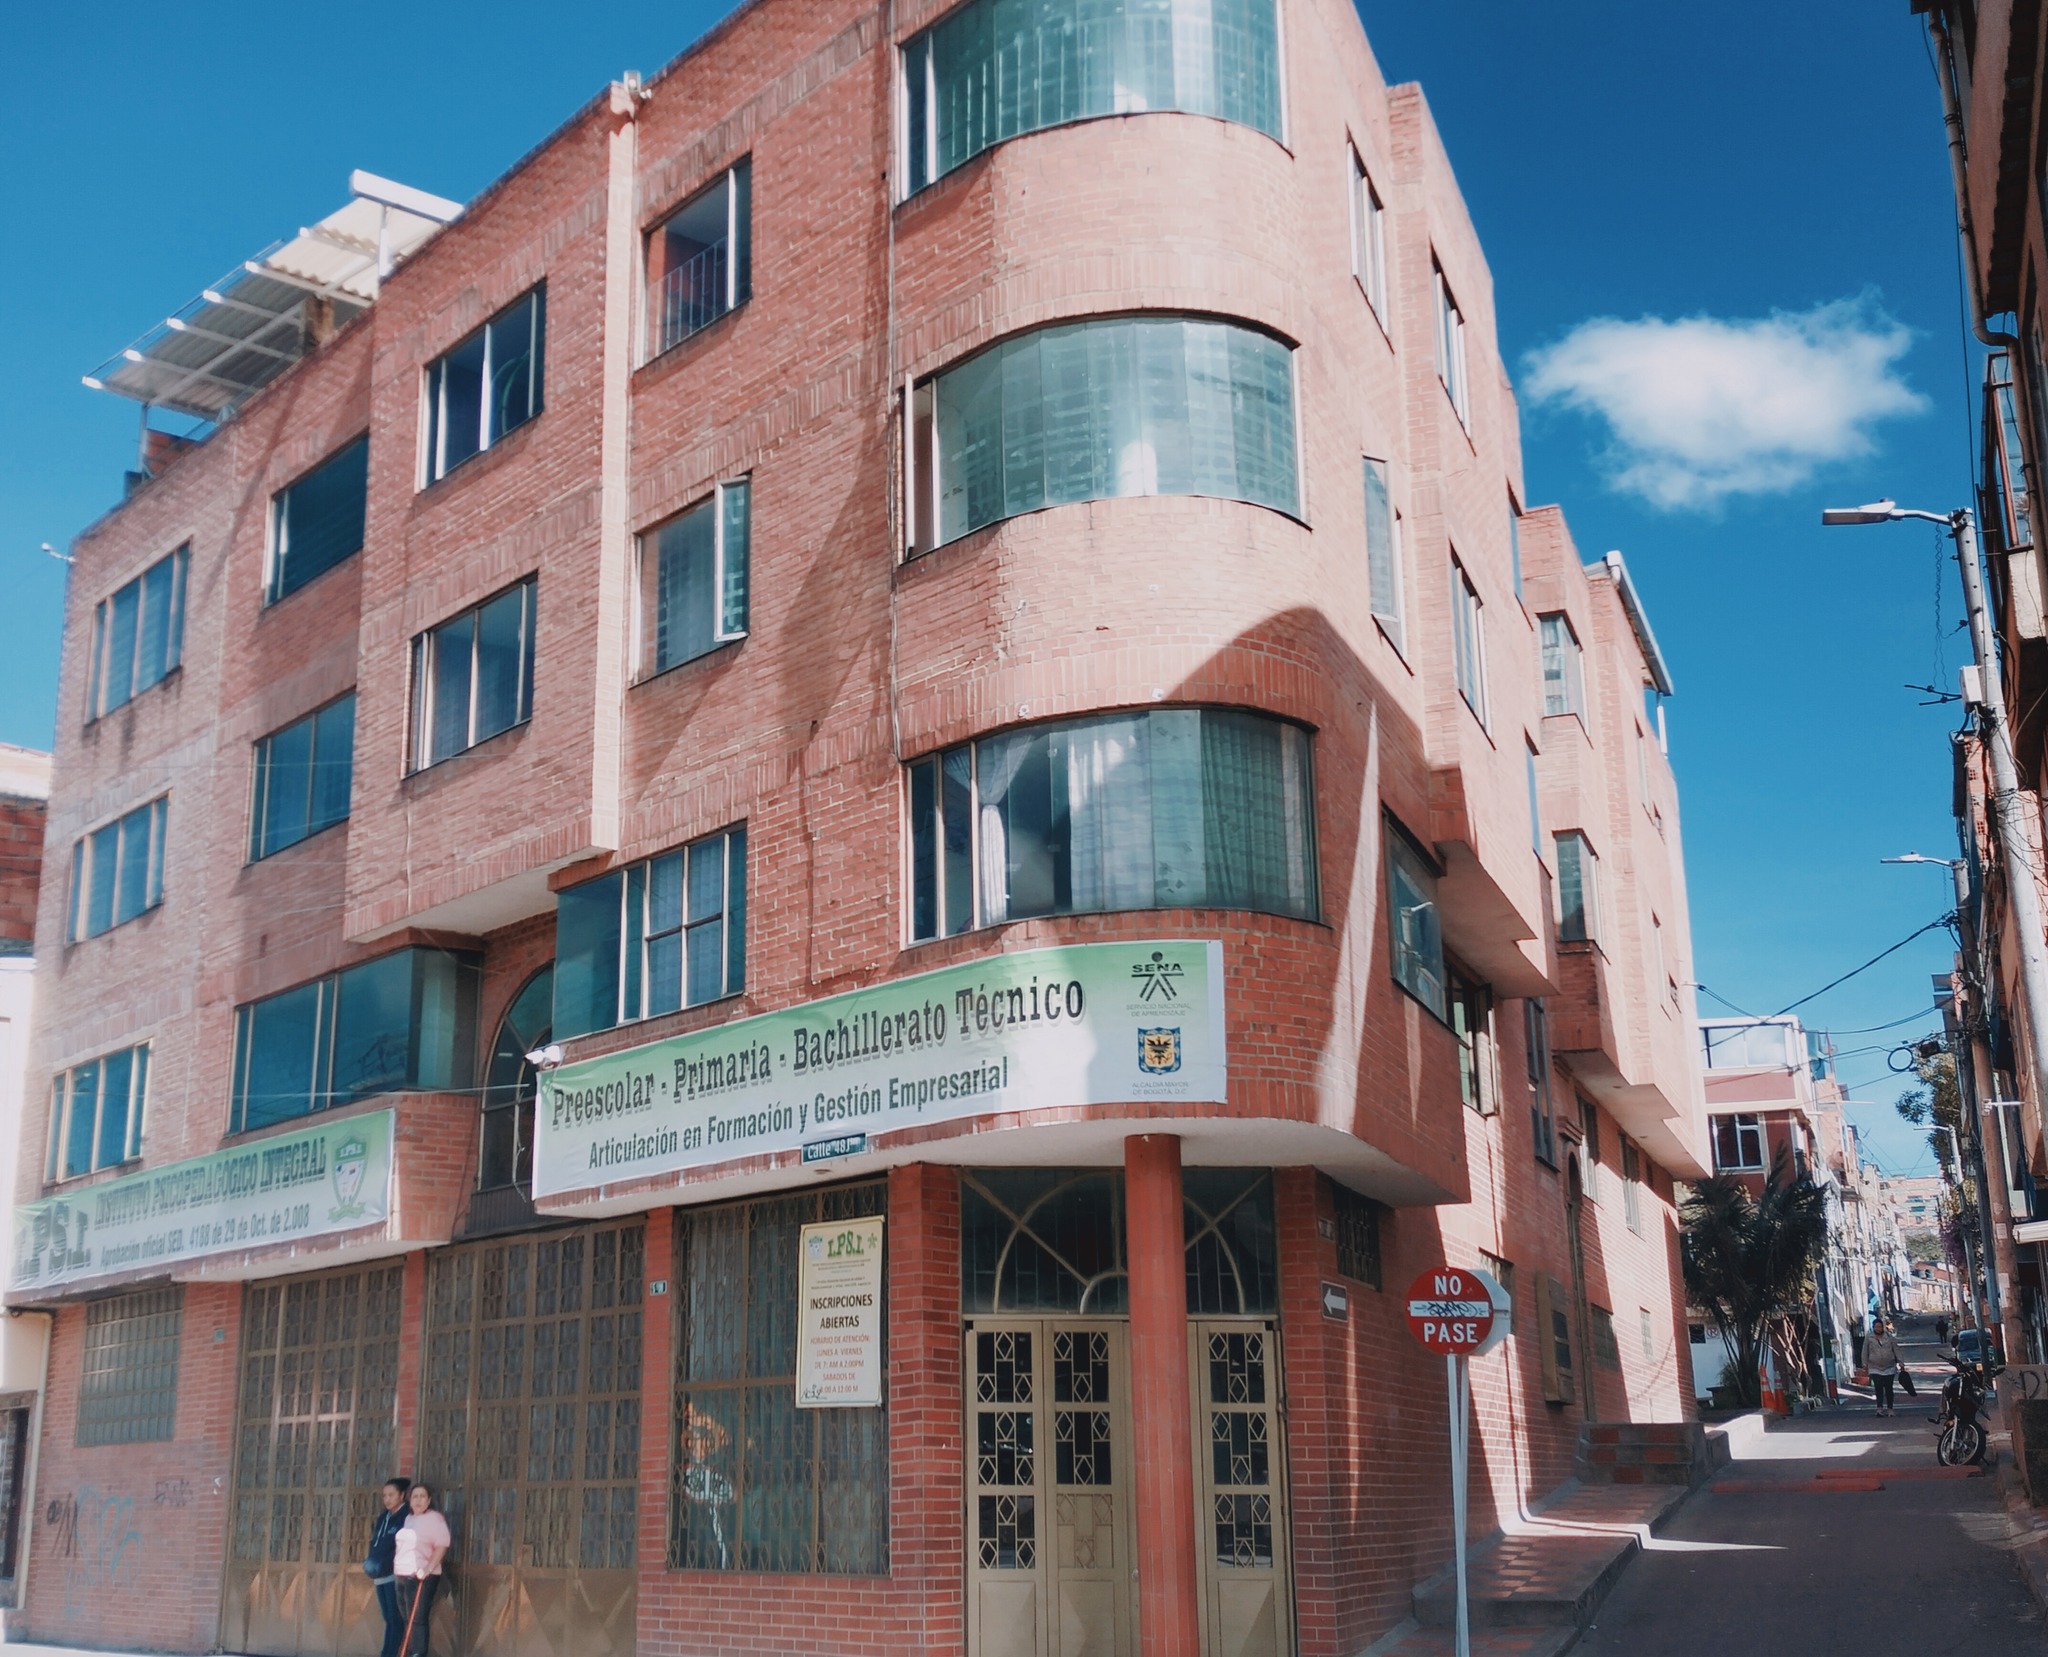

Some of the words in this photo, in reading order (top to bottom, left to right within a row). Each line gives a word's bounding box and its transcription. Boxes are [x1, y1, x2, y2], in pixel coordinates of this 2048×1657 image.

[1132, 963, 1183, 973] SENA
[1126, 1003, 1157, 1011] SERVICIO
[1158, 1002, 1191, 1010] NACIONAL
[552, 1071, 654, 1127] Preescolar
[673, 1040, 771, 1098] Primaria
[793, 1000, 947, 1070] Bachillerato
[955, 976, 1084, 1035] Técnico
[589, 1125, 678, 1169] Articulación
[684, 1125, 701, 1150] en
[708, 1101, 793, 1145] Formación
[799, 1103, 808, 1133] y
[815, 1083, 882, 1124] Gestión
[889, 1056, 1008, 1112] Empresarial
[807, 1142, 831, 1159] Calle
[260, 1136, 326, 1191] INTEGRAL
[142, 1232, 165, 1259] oficial
[212, 1222, 222, 1246] de
[224, 1218, 235, 1243] 29
[237, 1216, 247, 1240] de
[270, 1209, 281, 1234] de
[1434, 1275, 1462, 1295] NO
[810, 1293, 873, 1310] INSCRIPCIONES
[820, 1315, 860, 1329] ABIERTAS
[810, 1336, 833, 1344] HORARIO
[834, 1335, 841, 1344] DE
[1424, 1322, 1478, 1344] PASE
[817, 1348, 833, 1357] LUNES
[841, 1347, 863, 1356] VIERNES
[815, 1361, 821, 1369] DE
[829, 1360, 838, 1368] AM
[848, 1372, 855, 1380] DE
